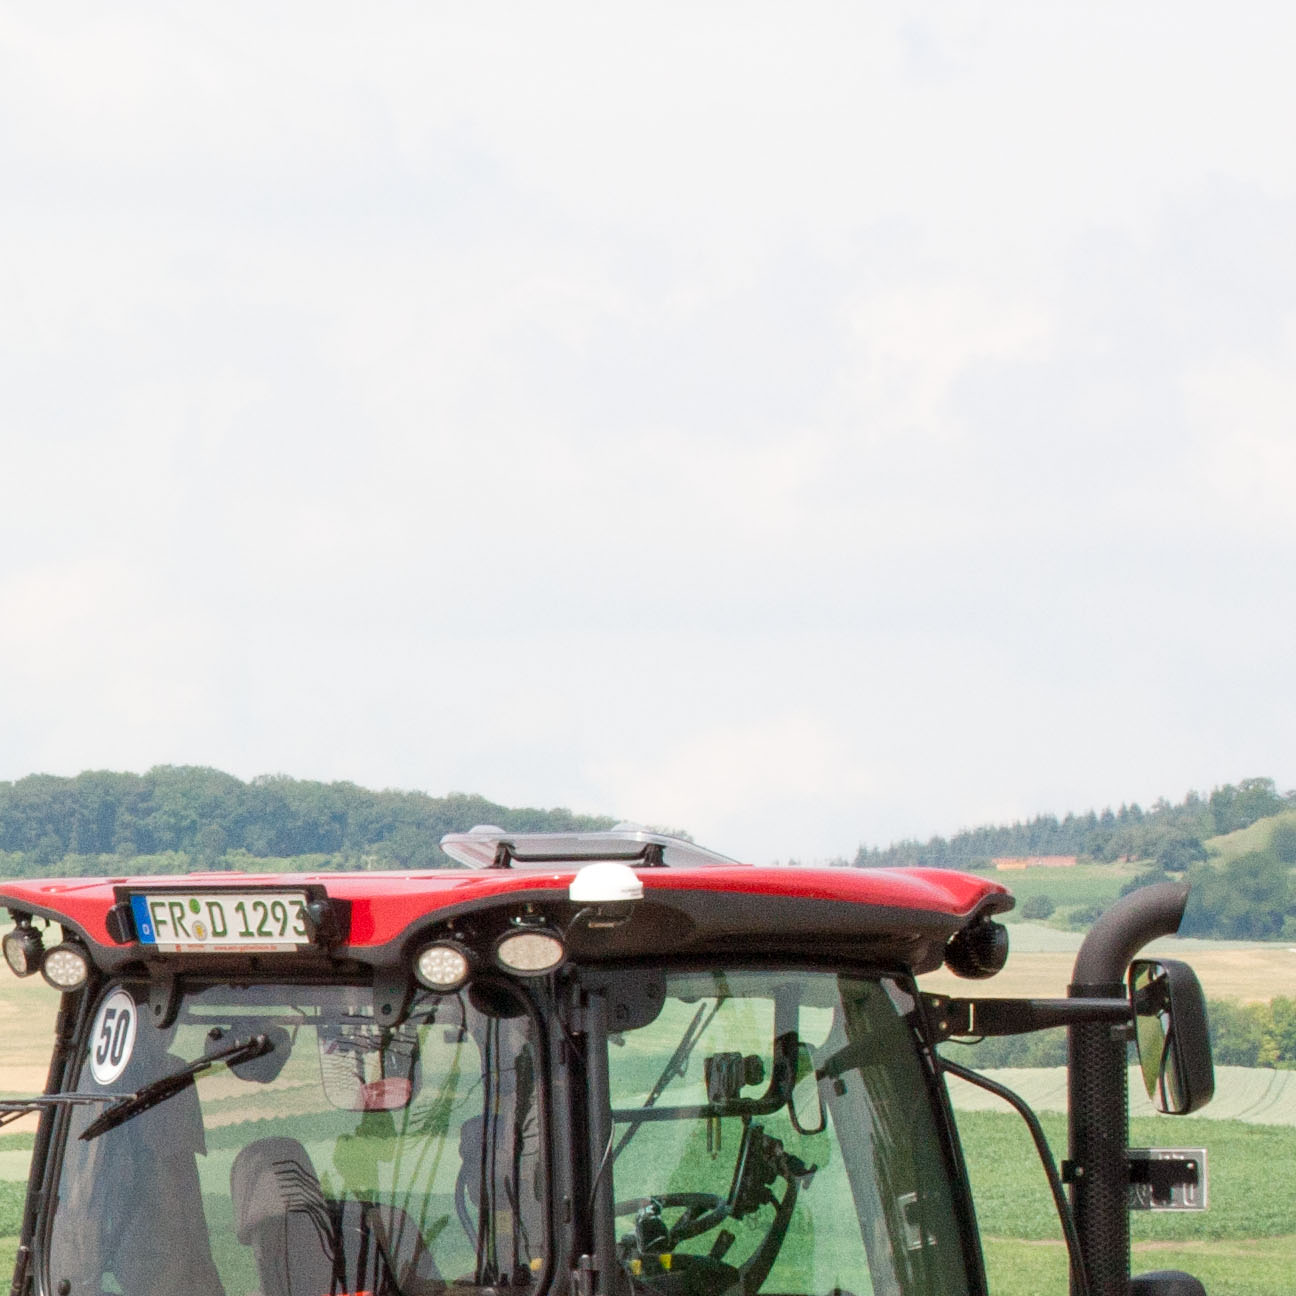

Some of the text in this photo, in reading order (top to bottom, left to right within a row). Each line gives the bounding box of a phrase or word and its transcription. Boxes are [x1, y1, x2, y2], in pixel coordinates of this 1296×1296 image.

[149, 900, 308, 938] FR D 1293
[96, 1008, 130, 1067] 50
